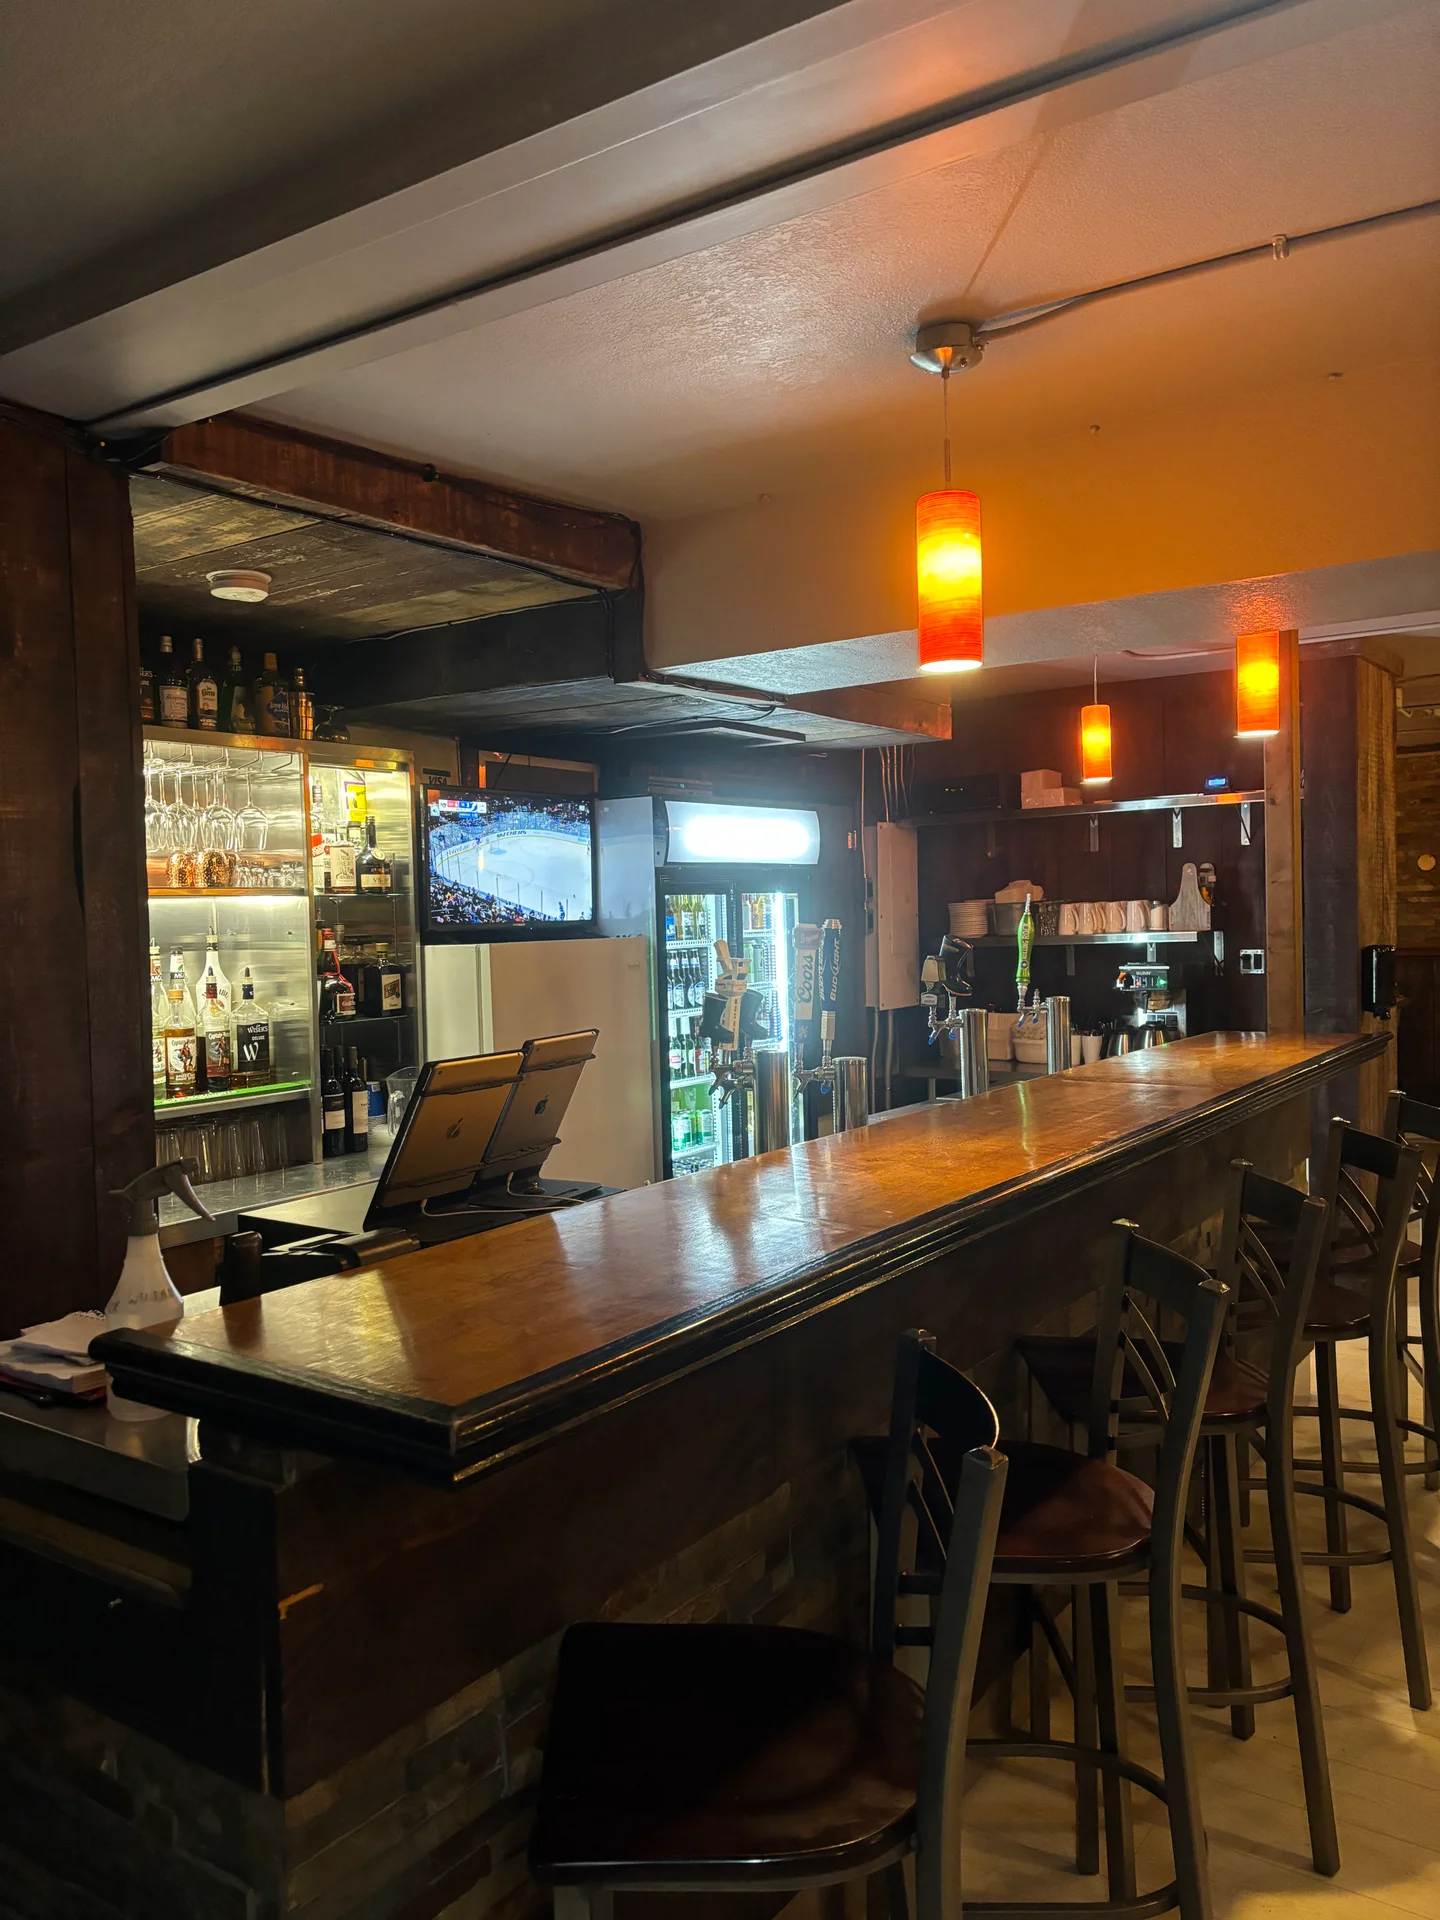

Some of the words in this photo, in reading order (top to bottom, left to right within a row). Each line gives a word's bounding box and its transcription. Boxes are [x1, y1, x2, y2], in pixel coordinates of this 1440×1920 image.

[428, 776, 448, 785] VISA
[832, 938, 841, 970] LIGHT
[797, 954, 813, 1003] Coors
[830, 976, 838, 1001] BUD
[242, 1042, 259, 1061] W
